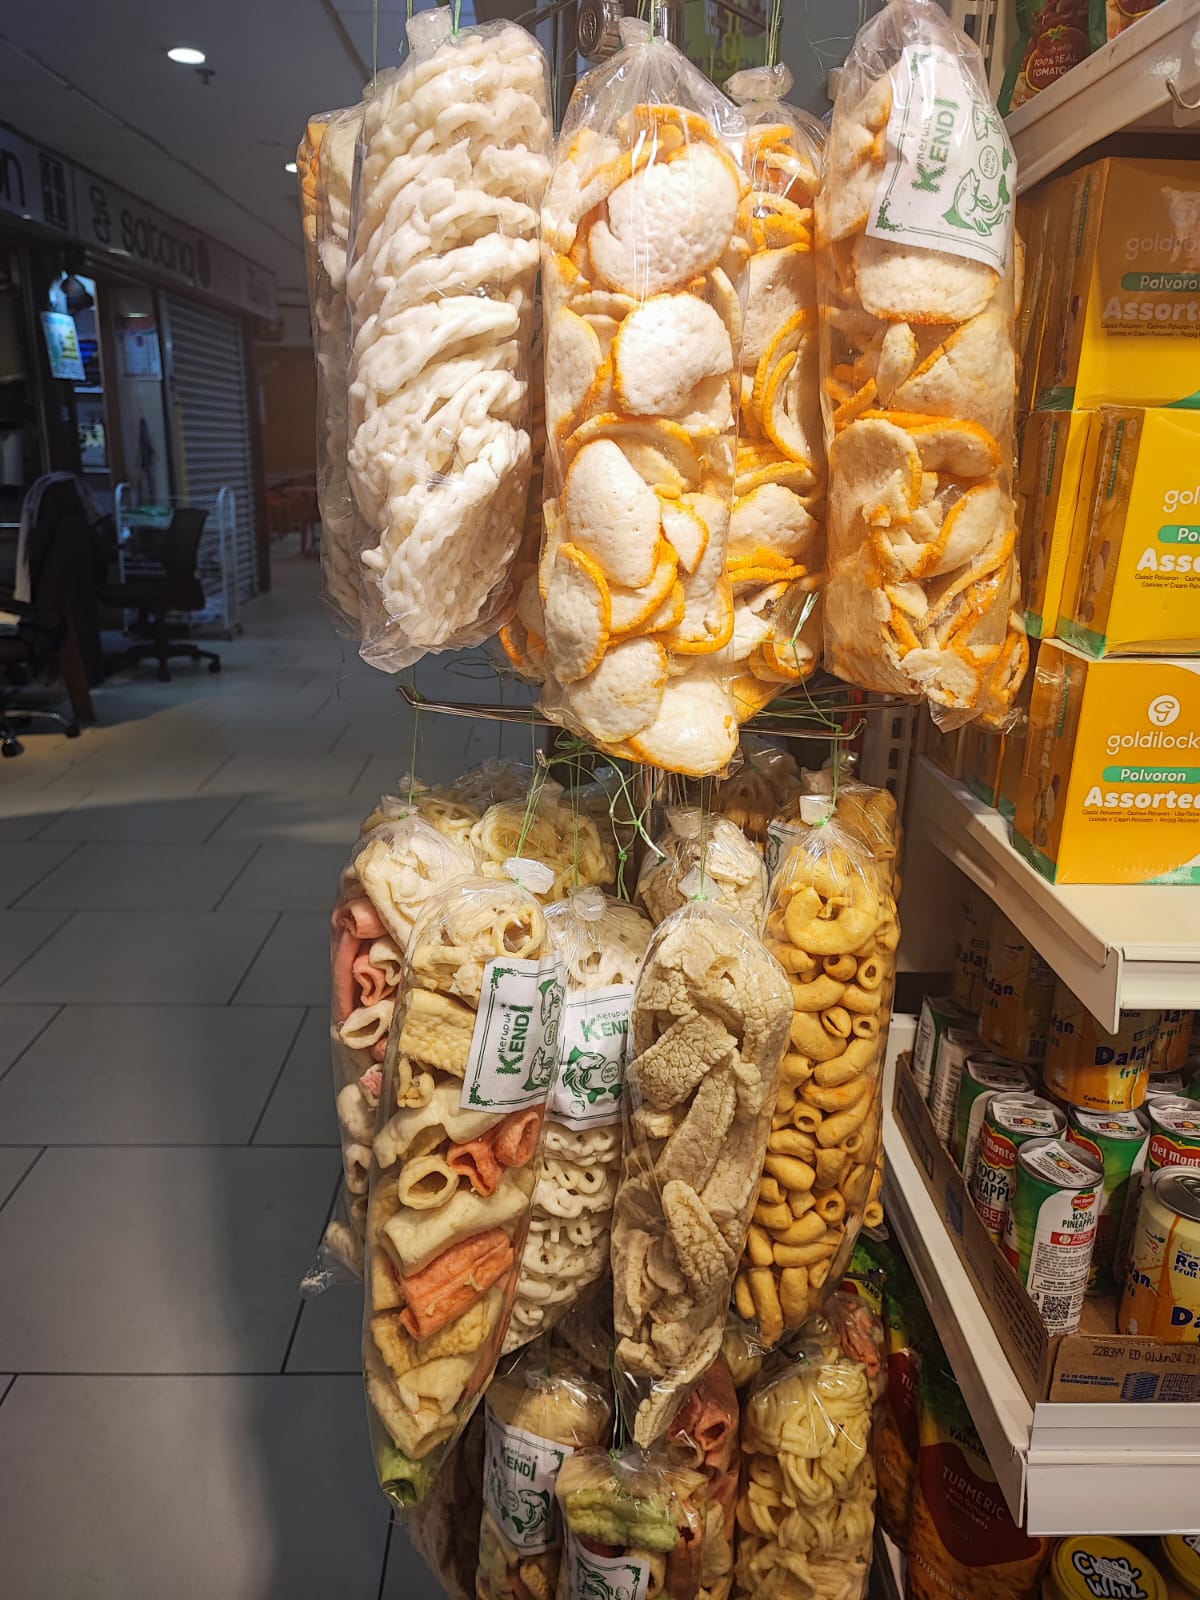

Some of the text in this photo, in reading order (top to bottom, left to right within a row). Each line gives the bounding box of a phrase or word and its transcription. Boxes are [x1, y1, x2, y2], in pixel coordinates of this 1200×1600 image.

[1139, 275, 1200, 290] Polvoro
[1102, 295, 1200, 322] Assort
[1120, 768, 1187, 782] Polvoron
[1152, 1141, 1167, 1158] Del
[1175, 1254, 1200, 1272] Re
[1174, 1265, 1197, 1279] Fruit
[942, 1465, 1006, 1521] TURMERIC
